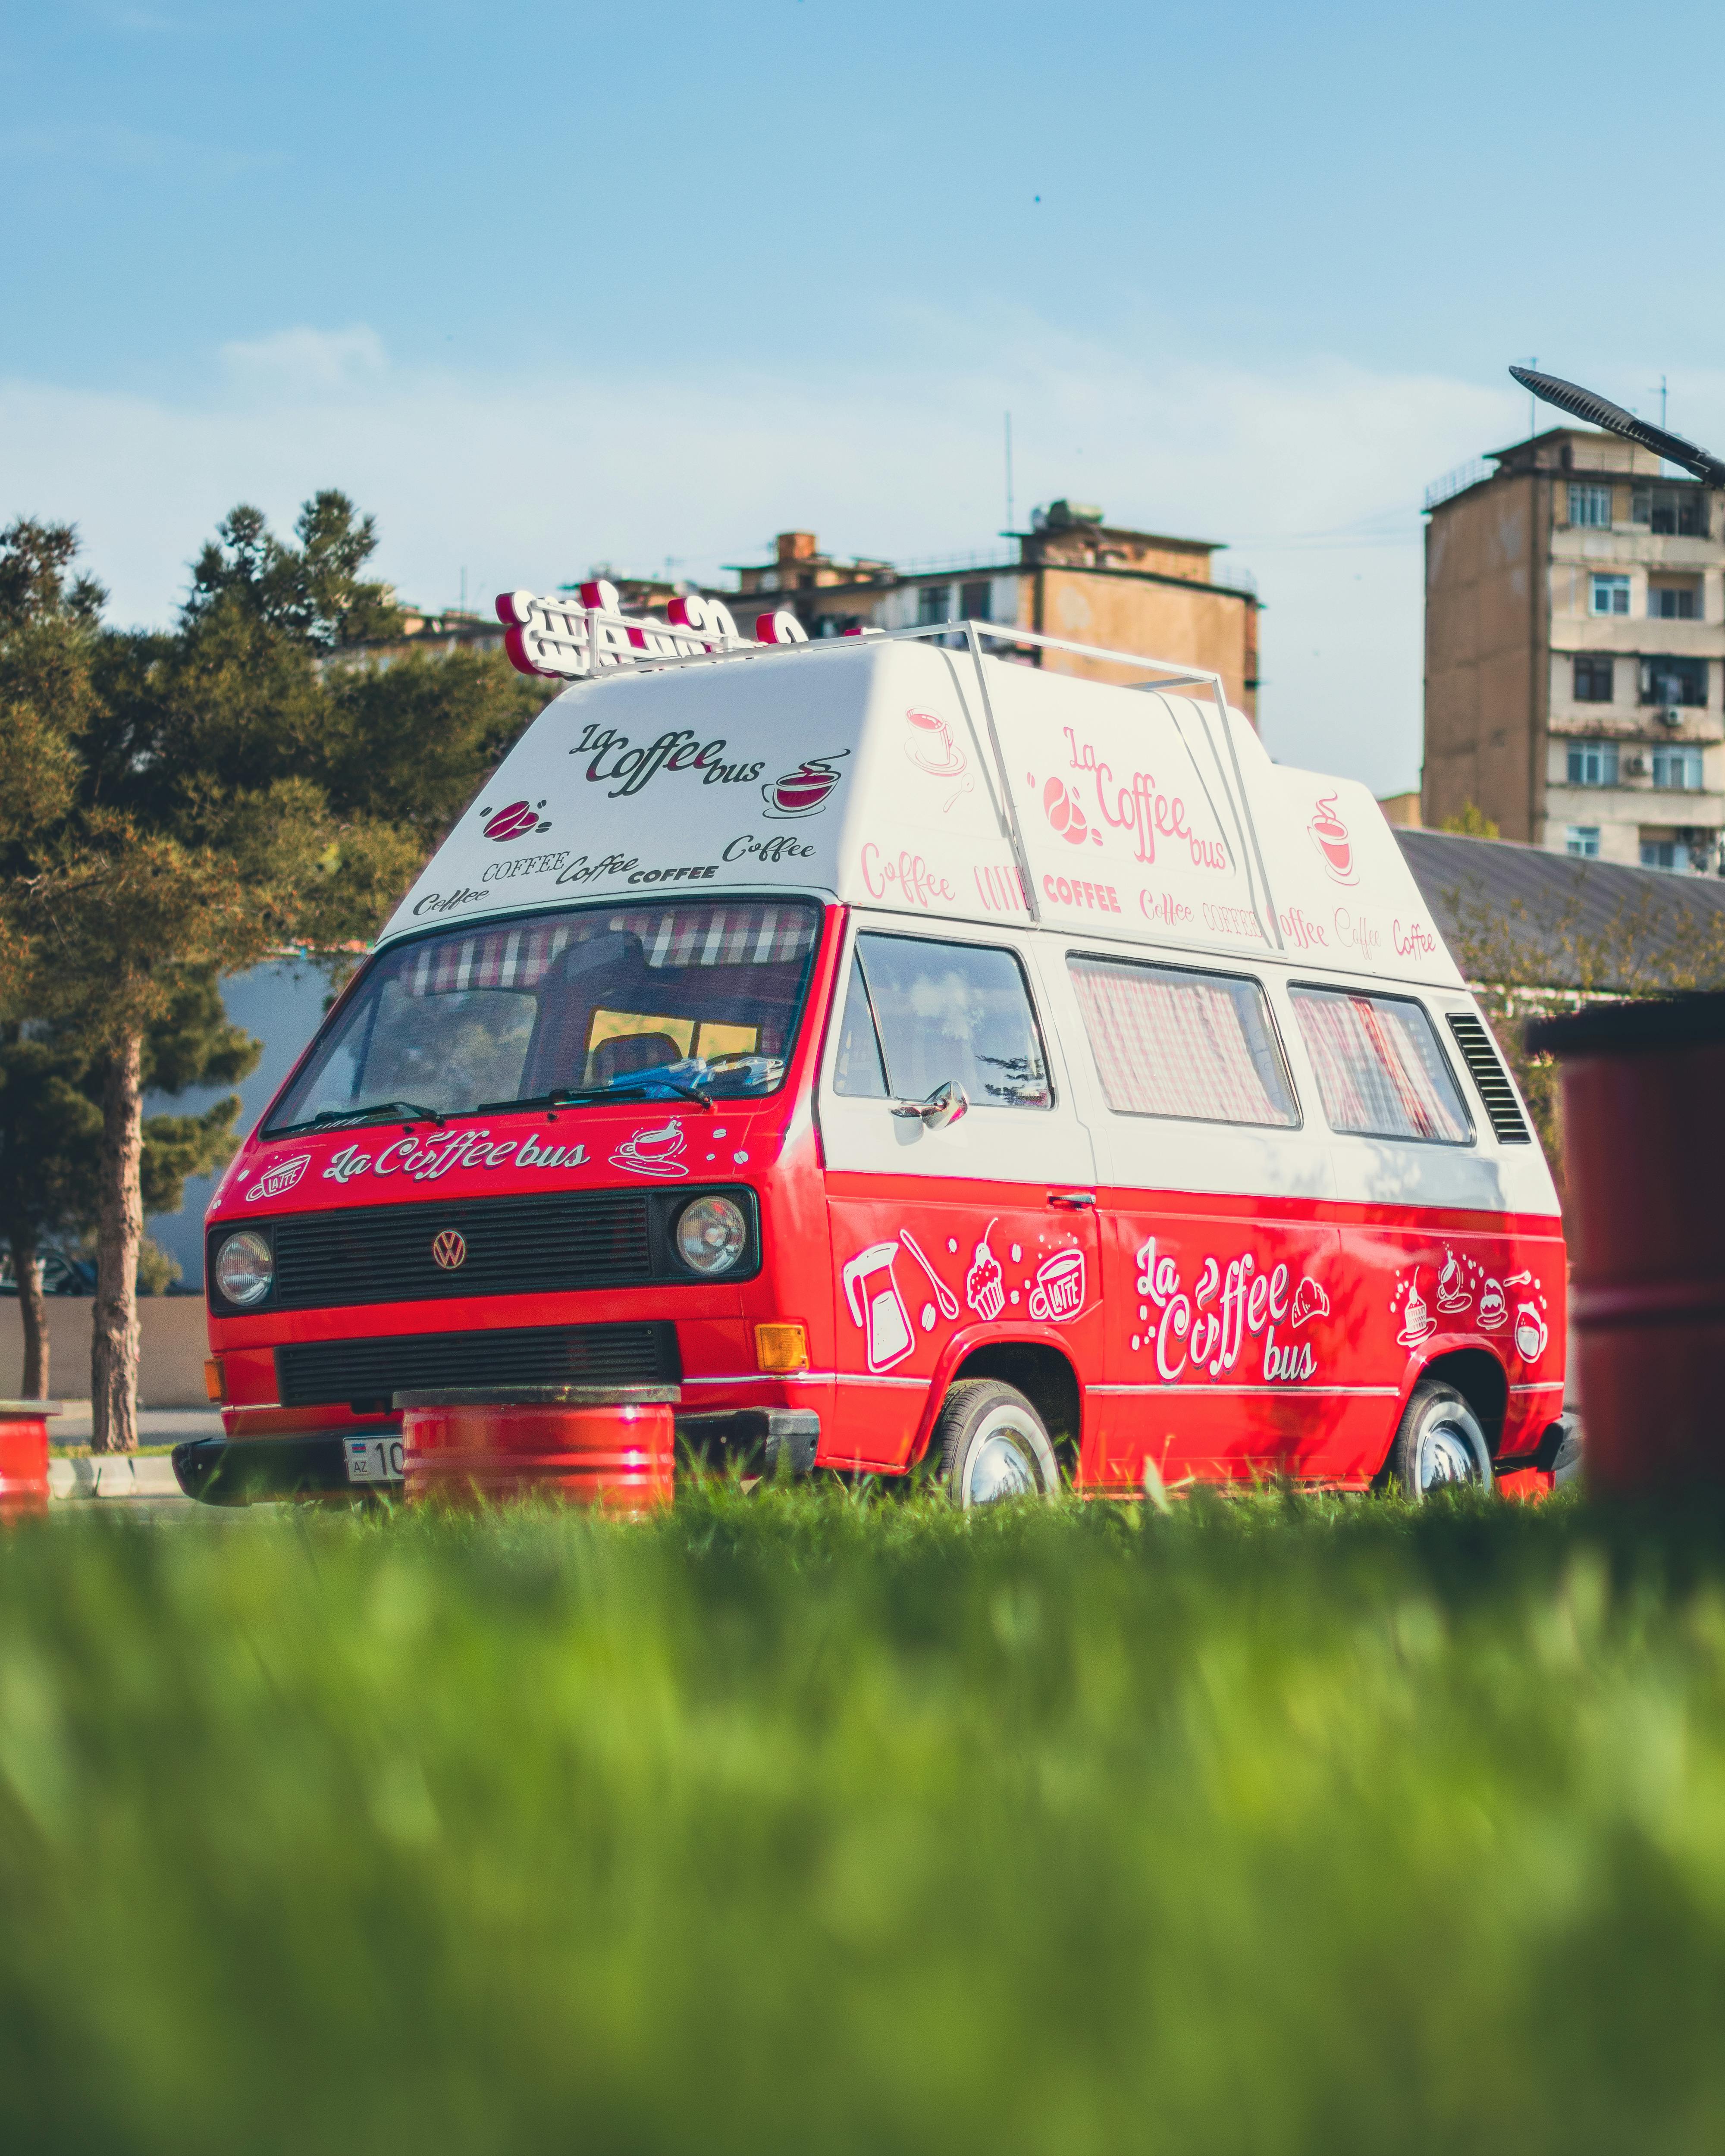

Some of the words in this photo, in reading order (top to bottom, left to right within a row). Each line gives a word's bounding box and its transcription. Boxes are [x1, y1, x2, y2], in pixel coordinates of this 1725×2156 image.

[569, 724, 617, 755] La
[1063, 726, 1100, 771] La
[586, 730, 727, 798] Coffee
[703, 755, 765, 784] bus
[1096, 762, 1189, 864] Coffee
[482, 851, 571, 882] COFFEE
[555, 853, 640, 885] Coffee
[722, 835, 816, 863] Coffee
[1188, 827, 1226, 870] bus
[627, 865, 719, 885] COFFEE
[413, 887, 490, 916] Coffee
[861, 842, 956, 909] Coffee
[1043, 874, 1122, 913] COFFEE
[1139, 889, 1194, 926] Coffee
[1202, 903, 1263, 938] COFFEE
[1333, 906, 1382, 961] Coffee
[1393, 919, 1436, 961] Coffee
[323, 1144, 372, 1184] La
[374, 1130, 517, 1181] Coffee
[514, 1134, 591, 1169] bus
[268, 1166, 301, 1193] LATTE
[433, 1229, 468, 1270] VW
[1047, 1271, 1079, 1314] LATTE
[1136, 1236, 1180, 1307] La
[1156, 1253, 1289, 1382] Coffee
[1264, 1326, 1317, 1381] bus
[354, 1461, 367, 1473] AZ
